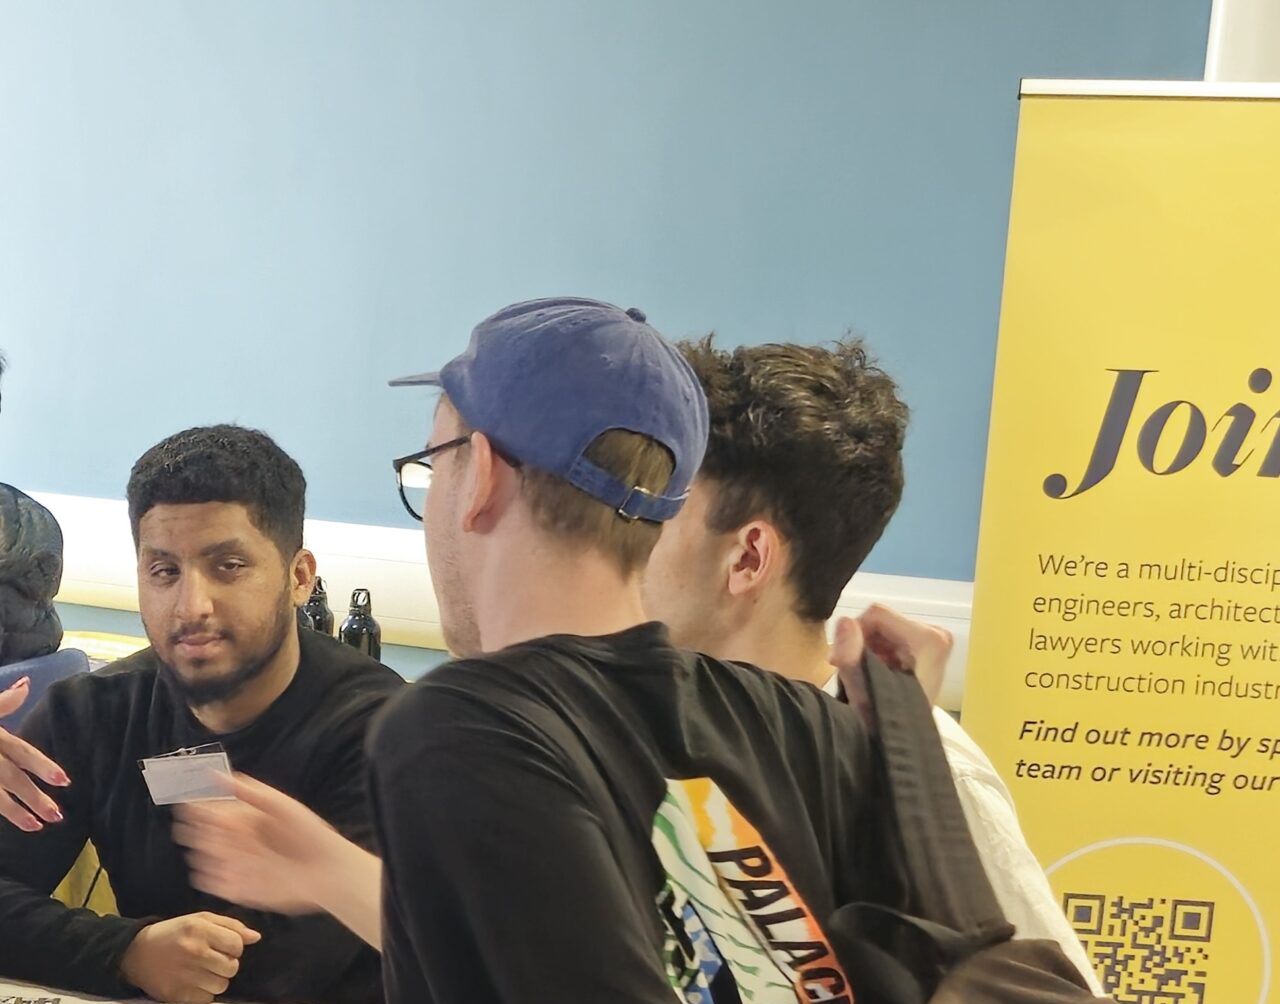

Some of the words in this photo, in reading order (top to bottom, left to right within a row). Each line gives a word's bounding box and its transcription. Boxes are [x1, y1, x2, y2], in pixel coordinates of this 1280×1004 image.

[1116, 561, 1130, 579] a
[1032, 593, 1161, 623] engineers,
[1168, 598, 1280, 624] architect
[1028, 628, 1122, 659] lawyers
[1130, 634, 1232, 667] working
[1240, 639, 1280, 662] wit
[1024, 671, 1185, 695] construction
[1018, 720, 1079, 744] Find
[1084, 727, 1131, 747] out
[1137, 730, 1210, 750] more
[1216, 729, 1251, 759] by
[1014, 759, 1082, 781] team
[1090, 765, 1121, 783] or
[1128, 762, 1226, 796] visiting
[1232, 773, 1280, 792] our
